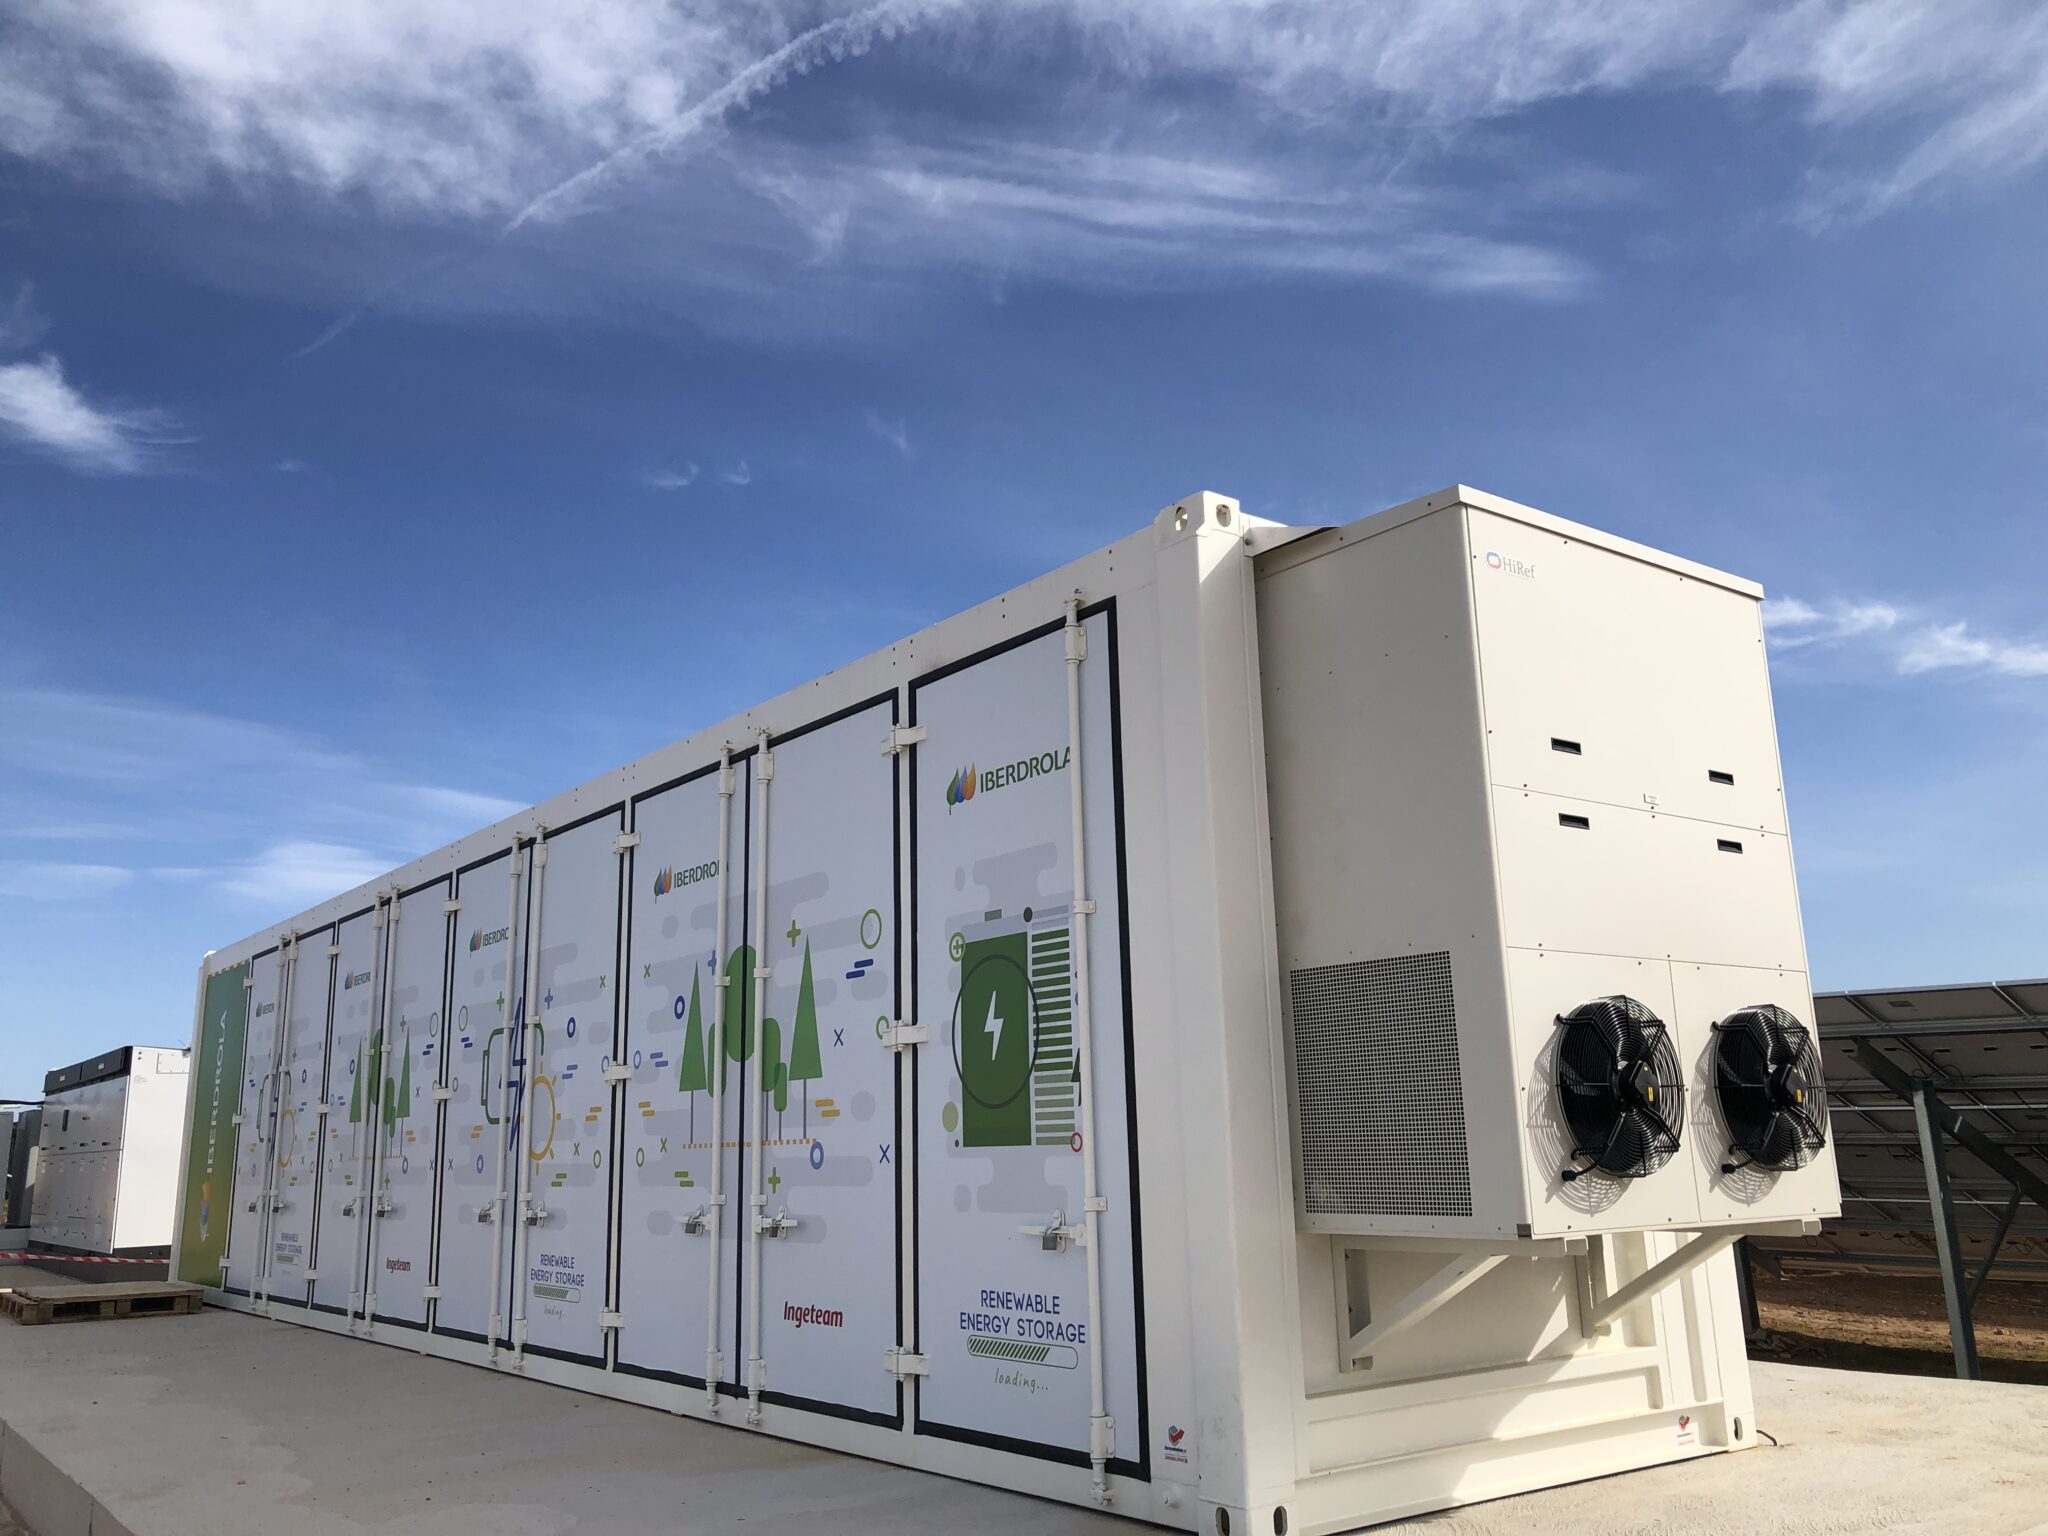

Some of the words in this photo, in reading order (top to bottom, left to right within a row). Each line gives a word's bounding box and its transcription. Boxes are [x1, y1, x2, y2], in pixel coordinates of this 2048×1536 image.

[1502, 556, 1535, 579] HiRef
[673, 860, 720, 889] IBERDRO
[206, 1009, 228, 1174] IBERDROLA
[386, 1256, 411, 1274] Ingeteam
[540, 1253, 575, 1270] RENEWABLE
[530, 1268, 553, 1282] ENERGY
[555, 1271, 585, 1287] STORAGE
[783, 1300, 843, 1329] Ingeteam
[980, 1289, 1060, 1315] RENEWABLE
[959, 1311, 1010, 1335] ENERGY
[1017, 1318, 1086, 1344] STORAGE
[994, 1367, 1049, 1394] loading...
